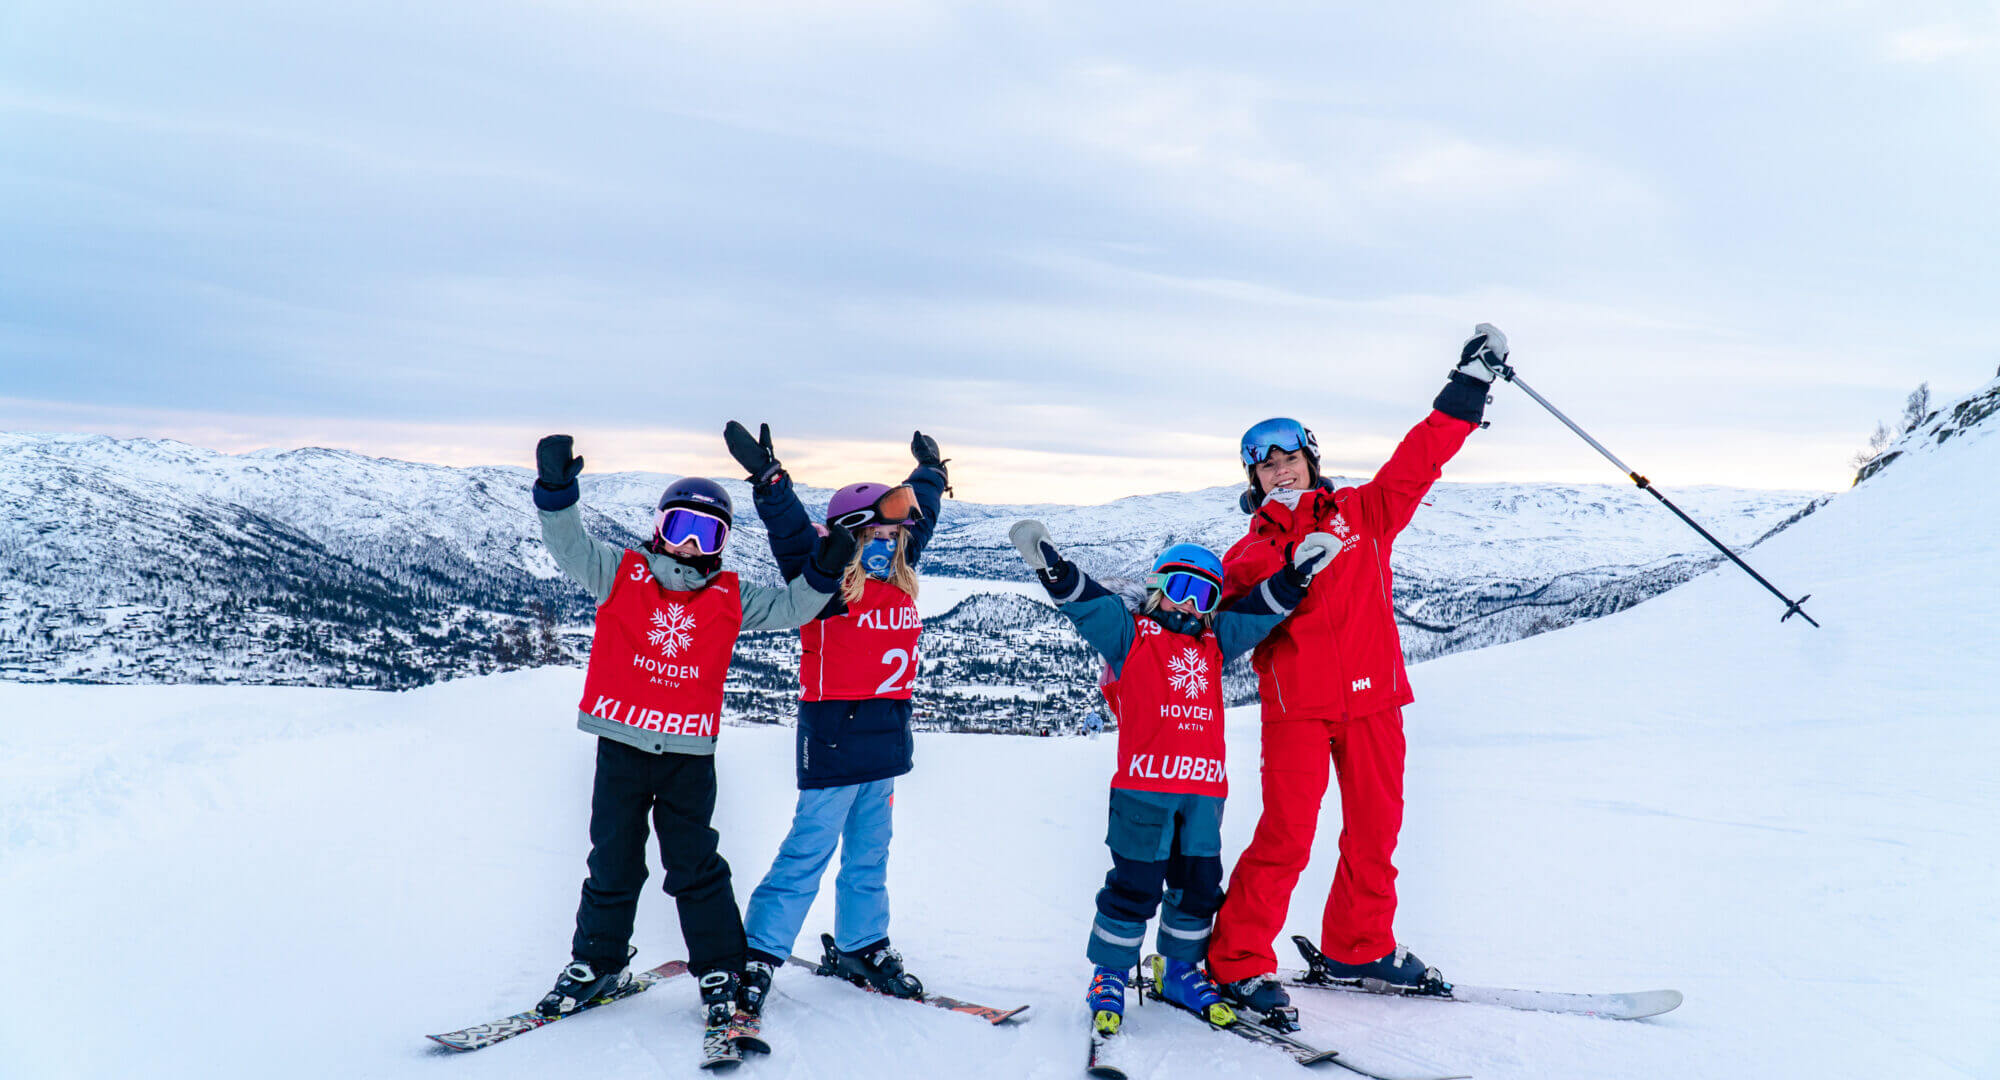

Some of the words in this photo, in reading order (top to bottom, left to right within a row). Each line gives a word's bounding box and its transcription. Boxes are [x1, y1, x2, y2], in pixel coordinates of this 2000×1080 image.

[857, 606, 922, 630] KLUBB
[1137, 618, 1162, 637] 29
[633, 653, 699, 679] HOVDEN
[649, 676, 680, 688] AKTIV
[1352, 677, 1371, 692] HH
[590, 695, 714, 736] KLUBBEN
[1160, 704, 1214, 722] HOVDEN
[1178, 722, 1204, 732] AKTIV
[1128, 753, 1226, 783] KLUBBEN
